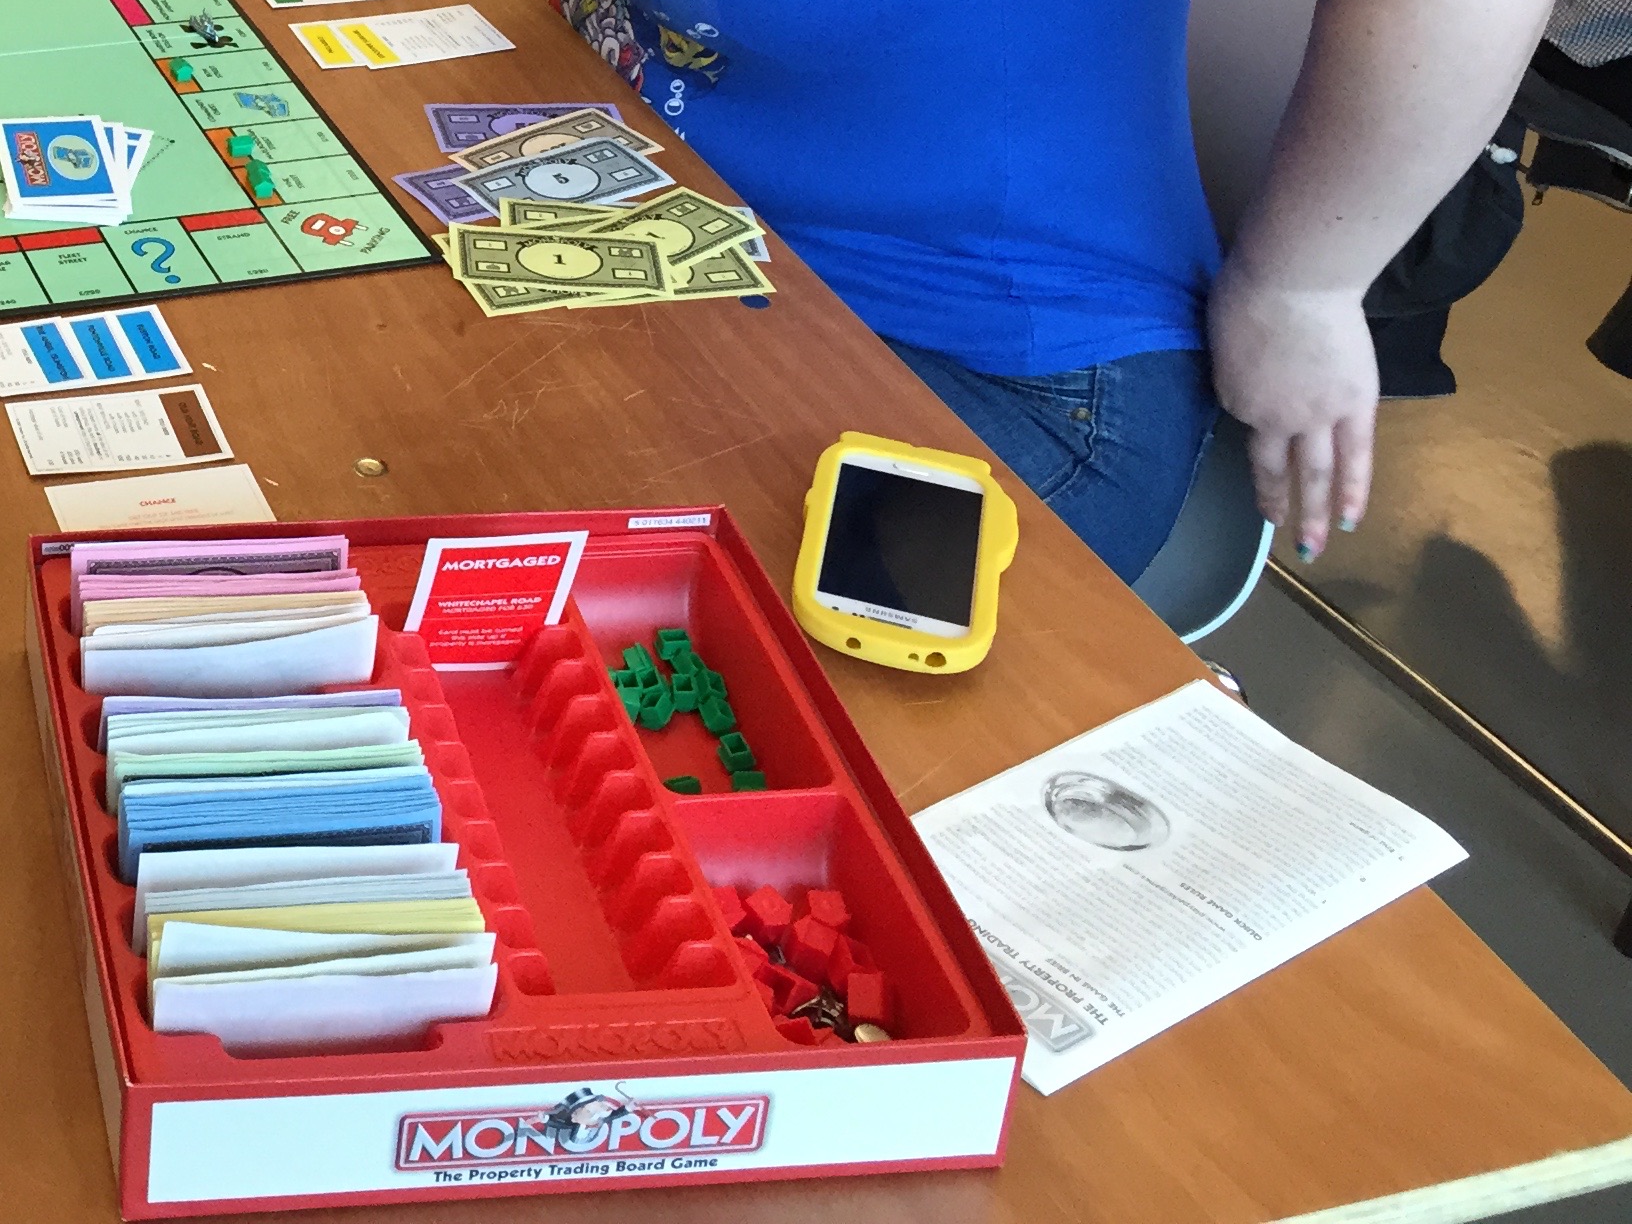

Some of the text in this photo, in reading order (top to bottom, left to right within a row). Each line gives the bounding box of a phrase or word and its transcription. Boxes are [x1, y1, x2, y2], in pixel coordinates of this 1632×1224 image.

[552, 172, 570, 185] 5
[552, 253, 567, 266] 1
[441, 554, 562, 572] MORTGAGED
[438, 595, 543, 609] WHITECHAPEL ROAD
[864, 606, 918, 624] SAMSUNG
[1234, 917, 1263, 941] QUICK
[1019, 958, 1083, 1005] PROPERTY
[1082, 1003, 1109, 1026] THE
[408, 1105, 755, 1163] MONOPOLY
[433, 1156, 719, 1184] The Property Trading Board Game
